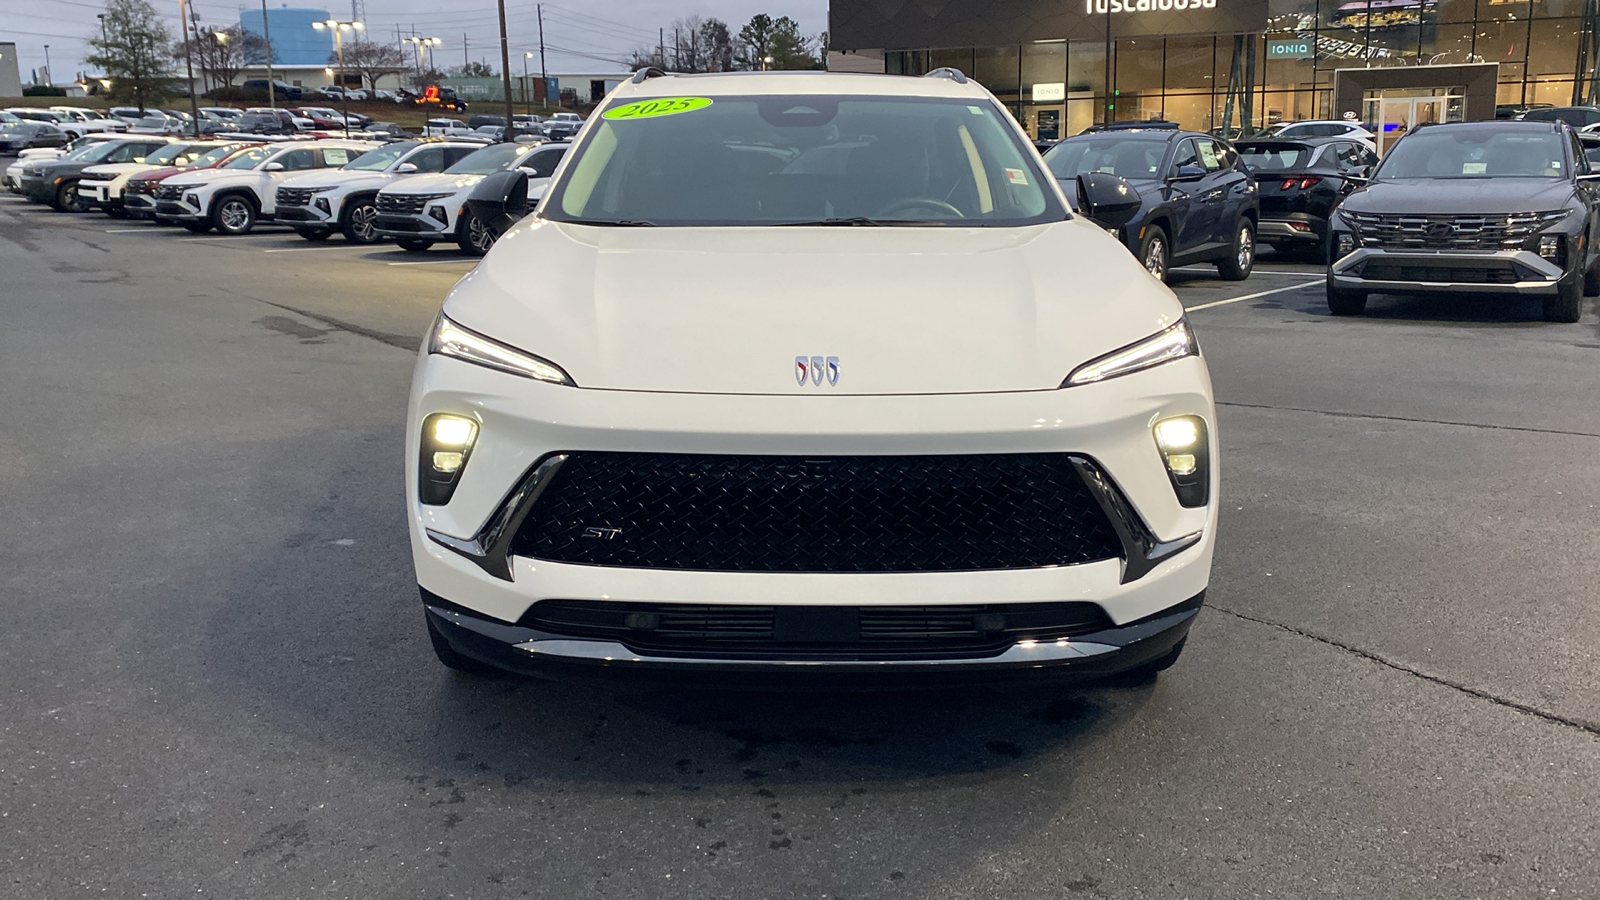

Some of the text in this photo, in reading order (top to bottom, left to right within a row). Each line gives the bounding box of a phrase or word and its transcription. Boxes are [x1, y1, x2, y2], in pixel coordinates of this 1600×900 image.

[1272, 44, 1308, 54] IONIQ
[619, 98, 696, 118] 2025
[581, 526, 623, 540] ST
